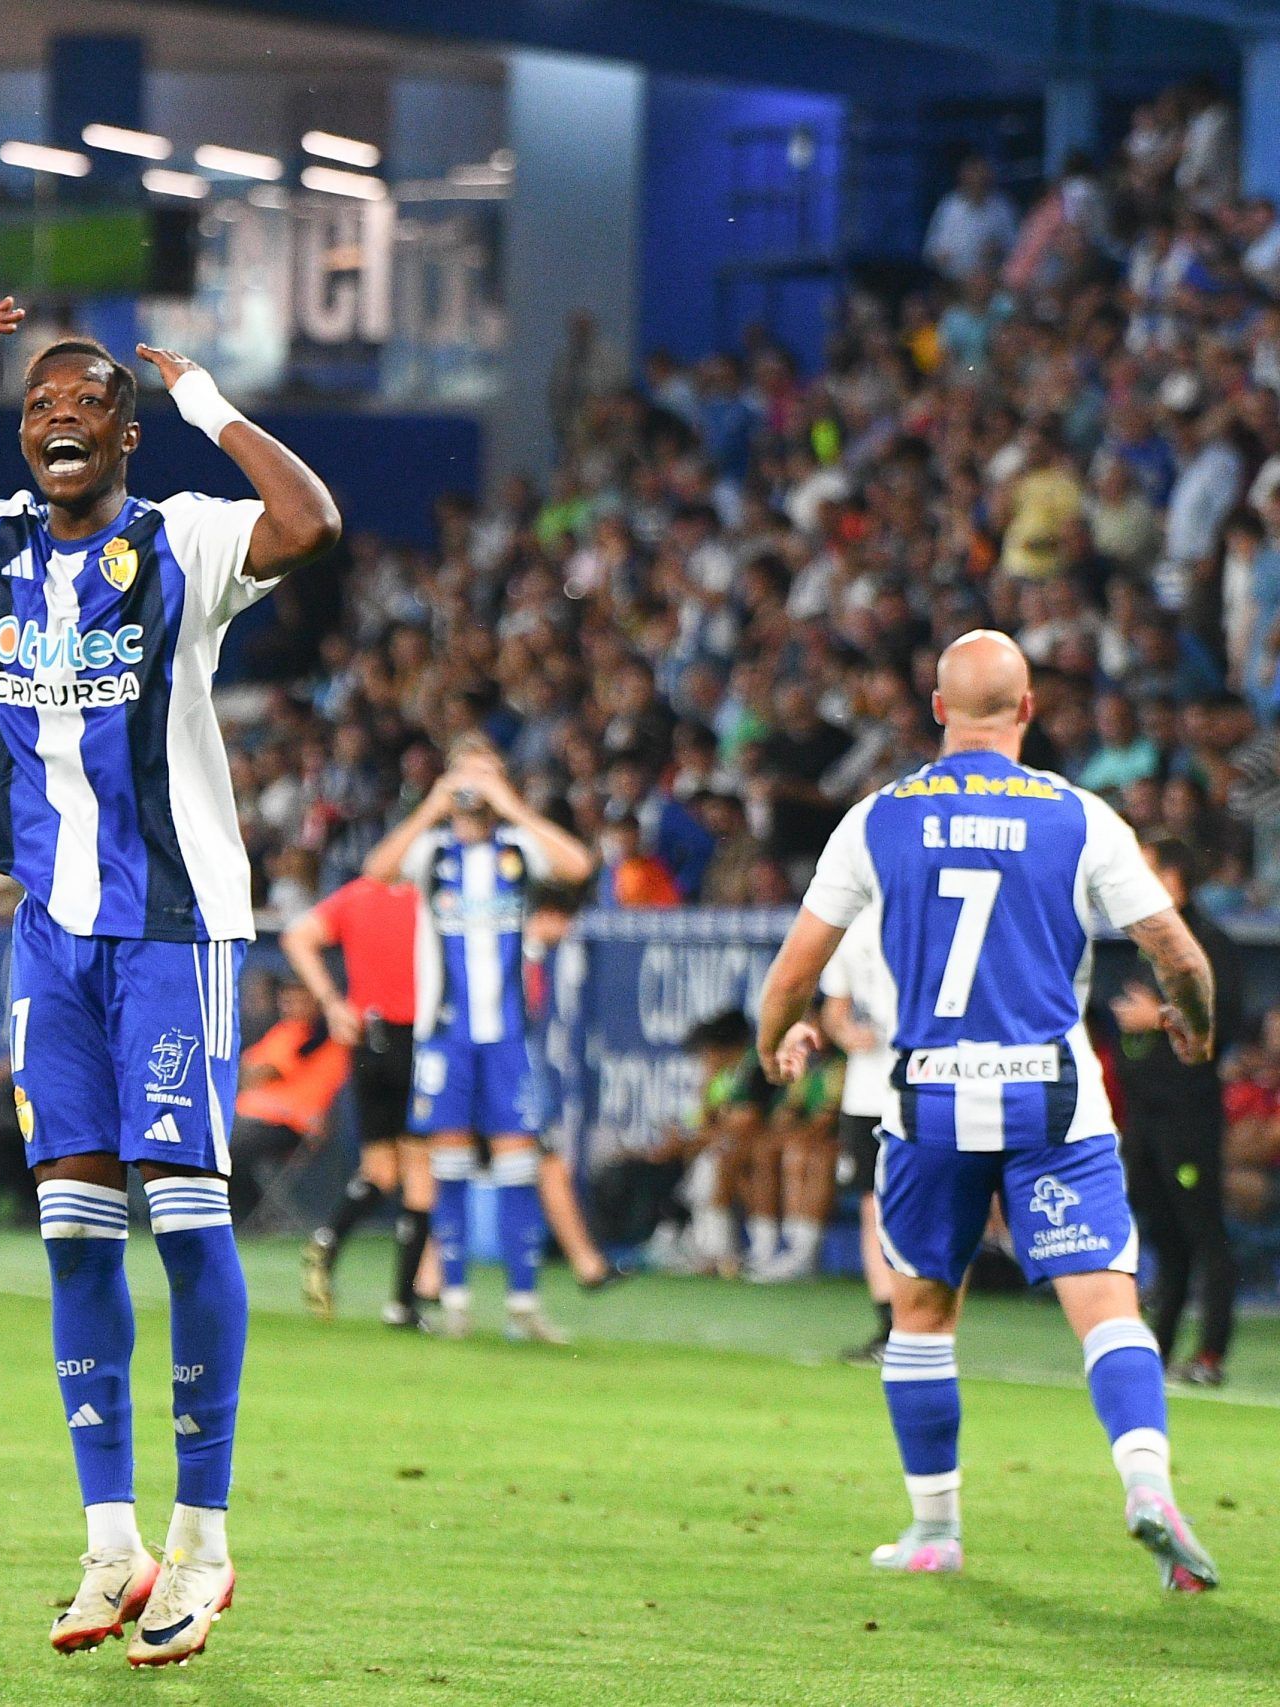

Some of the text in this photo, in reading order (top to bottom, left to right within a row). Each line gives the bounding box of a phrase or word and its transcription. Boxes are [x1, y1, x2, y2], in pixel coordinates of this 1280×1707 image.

[949, 814, 1027, 852] BENITO
[933, 868, 1001, 1018] 7
[935, 1060, 1052, 1080] VALCARCE
[56, 1358, 95, 1377] SDP
[172, 1364, 204, 1385] SDP
